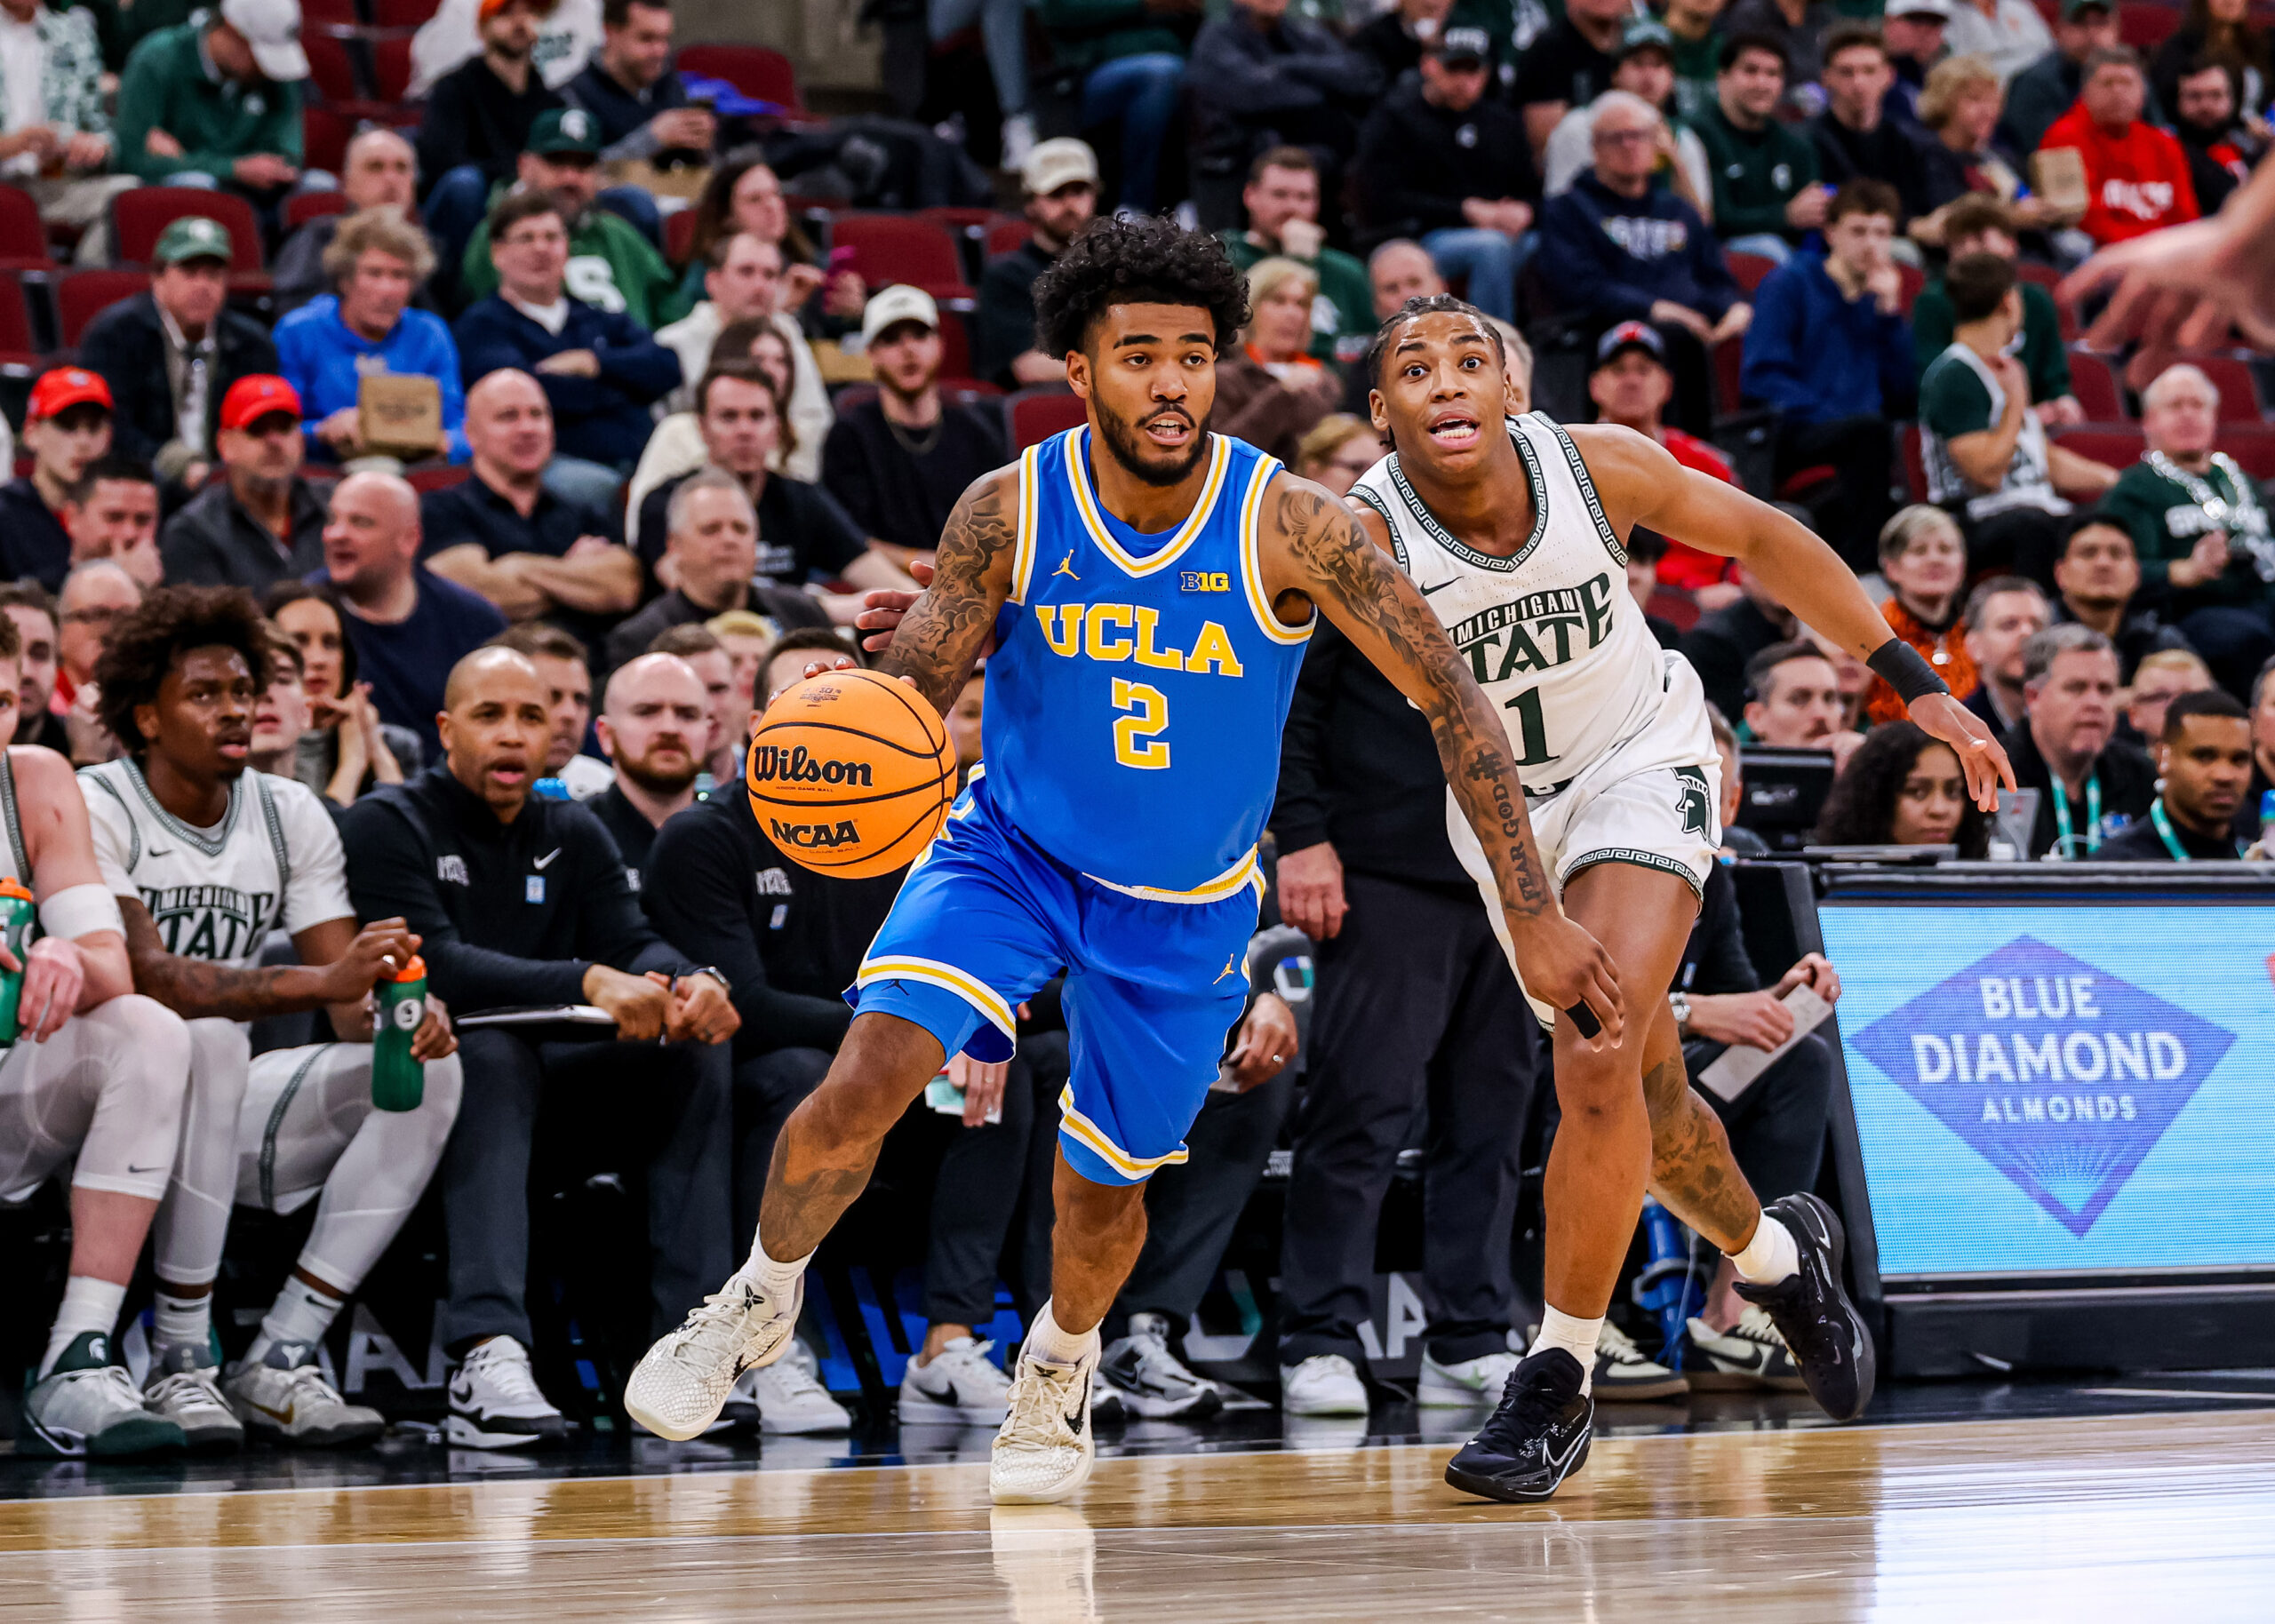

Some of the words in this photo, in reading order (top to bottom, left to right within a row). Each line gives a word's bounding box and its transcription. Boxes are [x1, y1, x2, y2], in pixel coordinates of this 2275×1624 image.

[1035, 603, 1244, 678] UCLA
[1449, 572, 1614, 685] TATE
[1457, 589, 1579, 645] MICHIGAN
[1112, 676, 1171, 770] 2
[1505, 686, 1561, 766] 1
[754, 744, 874, 787] Wilson
[770, 817, 861, 848] NCAA
[1492, 783, 1520, 839] GOD
[1511, 840, 1542, 903] FEAR
[1978, 975, 2103, 1020] BLUE
[1911, 1031, 2188, 1084] DIAMOND
[1980, 1095, 2138, 1124] ALMONDS
